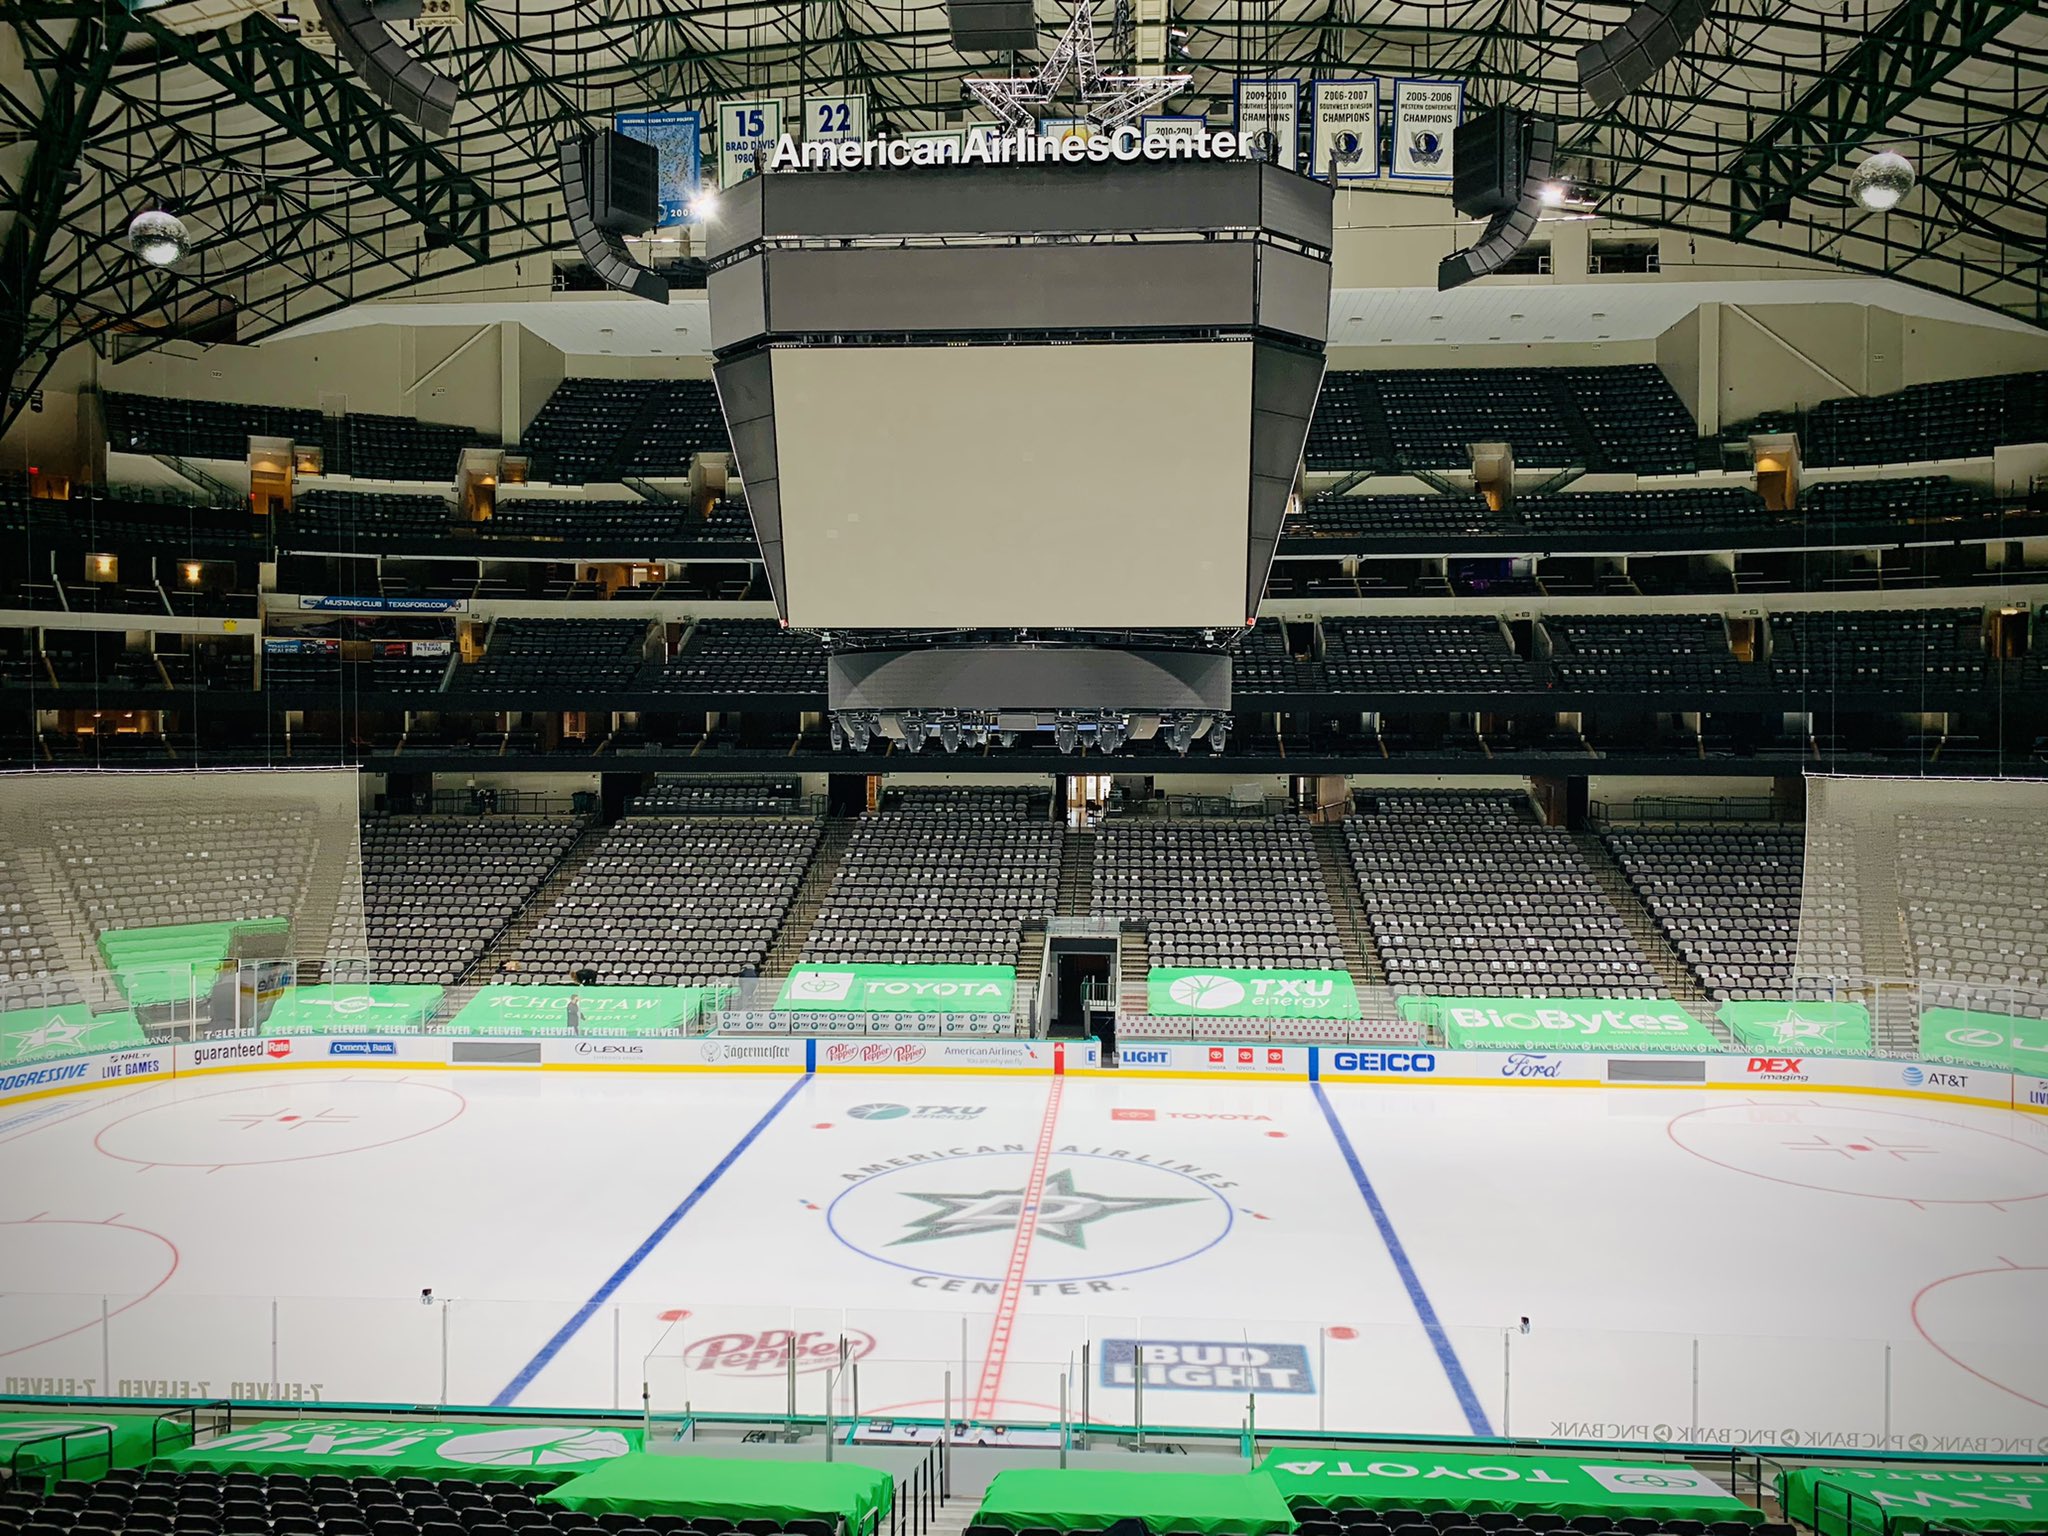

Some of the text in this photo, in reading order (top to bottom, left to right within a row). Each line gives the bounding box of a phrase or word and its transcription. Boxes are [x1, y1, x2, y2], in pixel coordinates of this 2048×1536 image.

[1324, 91, 1368, 100] 2006-2007
[1406, 91, 1452, 102] 2005-2006
[735, 109, 766, 138] 15
[818, 103, 851, 133] 22
[1322, 112, 1370, 123] CHAMPIONS
[1403, 113, 1453, 123] CHAMPIONS
[725, 139, 775, 152] BRAD DAVIS
[324, 599, 362, 607] MUSTANG
[362, 600, 383, 608] CLUB
[387, 601, 448, 609] TEXASFORD.COM
[866, 981, 1002, 997] TOYOTA
[1251, 978, 1334, 998] TXU
[1251, 994, 1331, 1009] energy
[503, 1012, 562, 1020] CASINOS
[194, 1041, 290, 1065] guaranteed Rate
[373, 1043, 393, 1053] Bank
[593, 1045, 644, 1054] LEXUS
[944, 1046, 1023, 1056] American Airlines
[1122, 1051, 1169, 1063] LIGHT
[1334, 1052, 1436, 1073] GEICO
[102, 1060, 159, 1079] LIVE GAMES
[1501, 1053, 1562, 1078] Ford
[1747, 1057, 1803, 1073] DEX
[0, 1063, 90, 1092] ROGRESSIVE
[1760, 1073, 1809, 1082] imaging
[1928, 1073, 1969, 1088] AT&T
[911, 1111, 980, 1121] energy
[915, 1104, 988, 1116] TXU
[1167, 1111, 1272, 1122] TOYOTA
[841, 1144, 1239, 1191] AMERICAN AIRLINES
[754, 1329, 824, 1350] Dr
[696, 1333, 864, 1377] Pepper
[1141, 1344, 1270, 1367] BUD
[1113, 1364, 1301, 1390] LIGHT
[185, 1433, 427, 1457] TXU
[1274, 1460, 1570, 1484] TOYOTA
